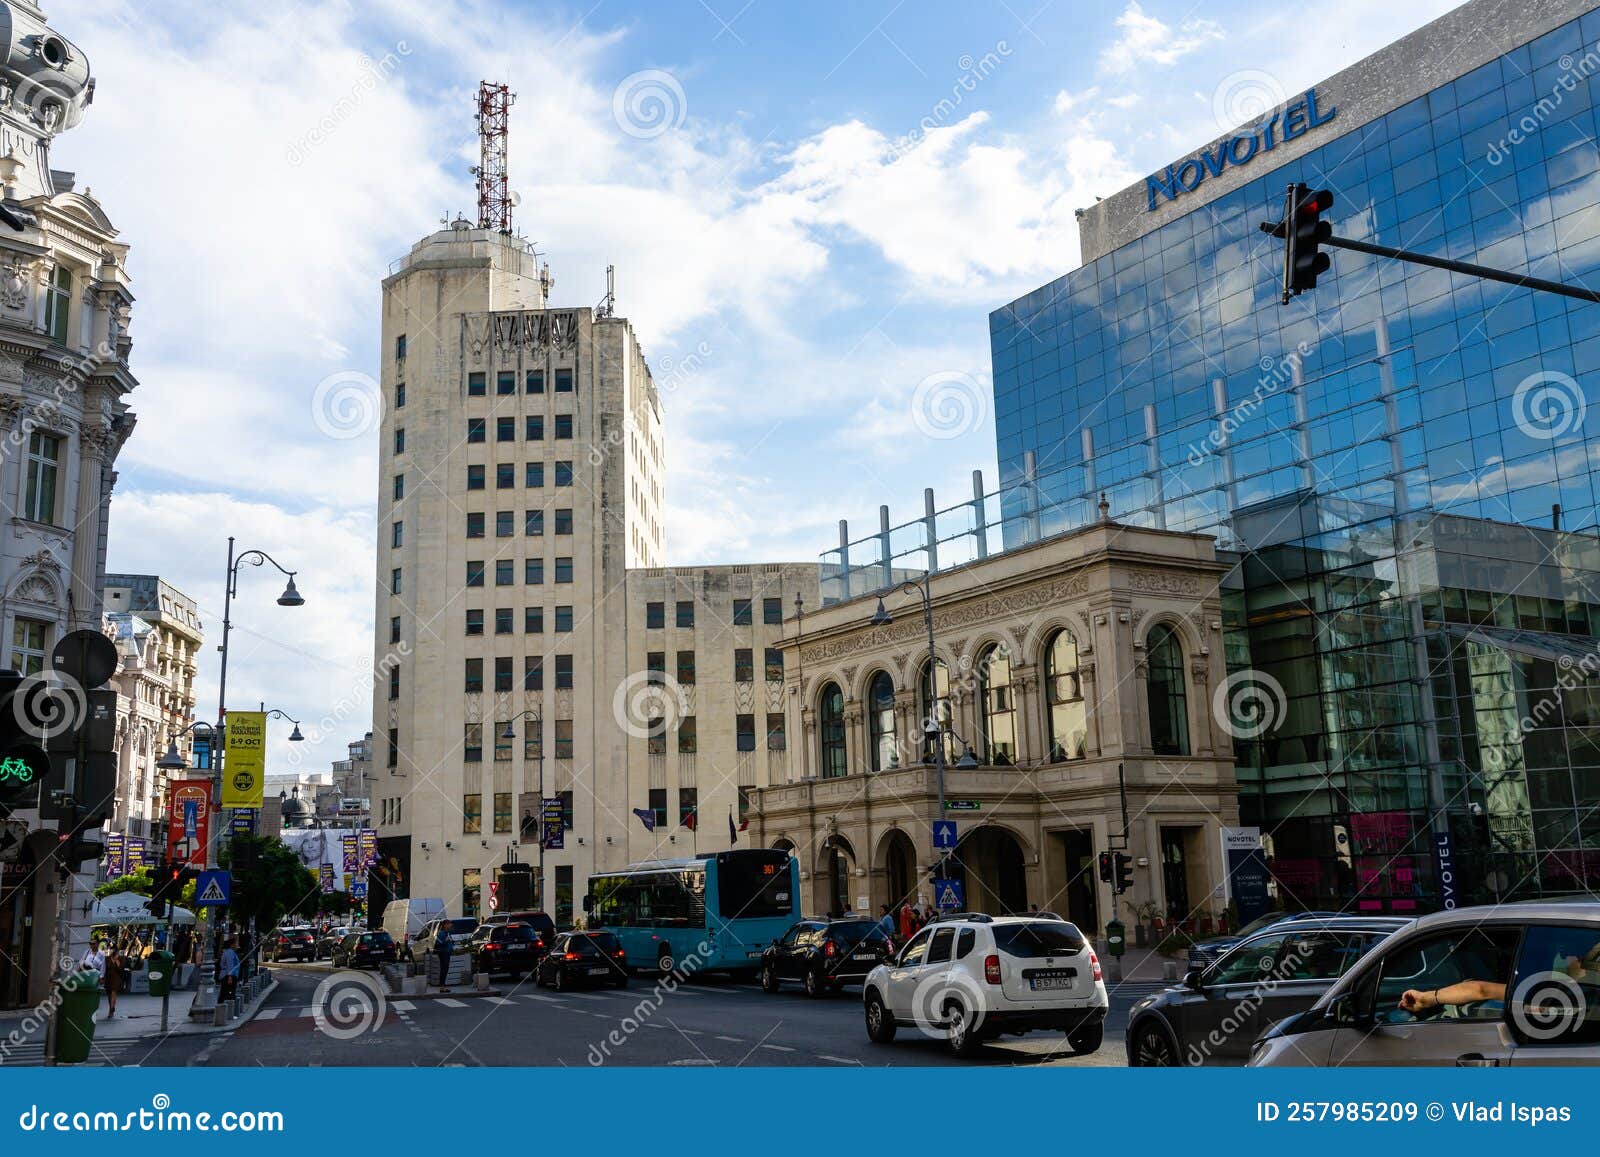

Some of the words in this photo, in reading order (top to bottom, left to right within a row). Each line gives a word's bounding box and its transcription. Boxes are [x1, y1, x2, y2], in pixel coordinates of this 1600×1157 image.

[1146, 88, 1336, 212] NOVOTEL
[175, 803, 205, 813] KG
[3, 863, 14, 873] DY
[15, 863, 32, 873] CAT
[1438, 836, 1456, 911] OVOTEL
